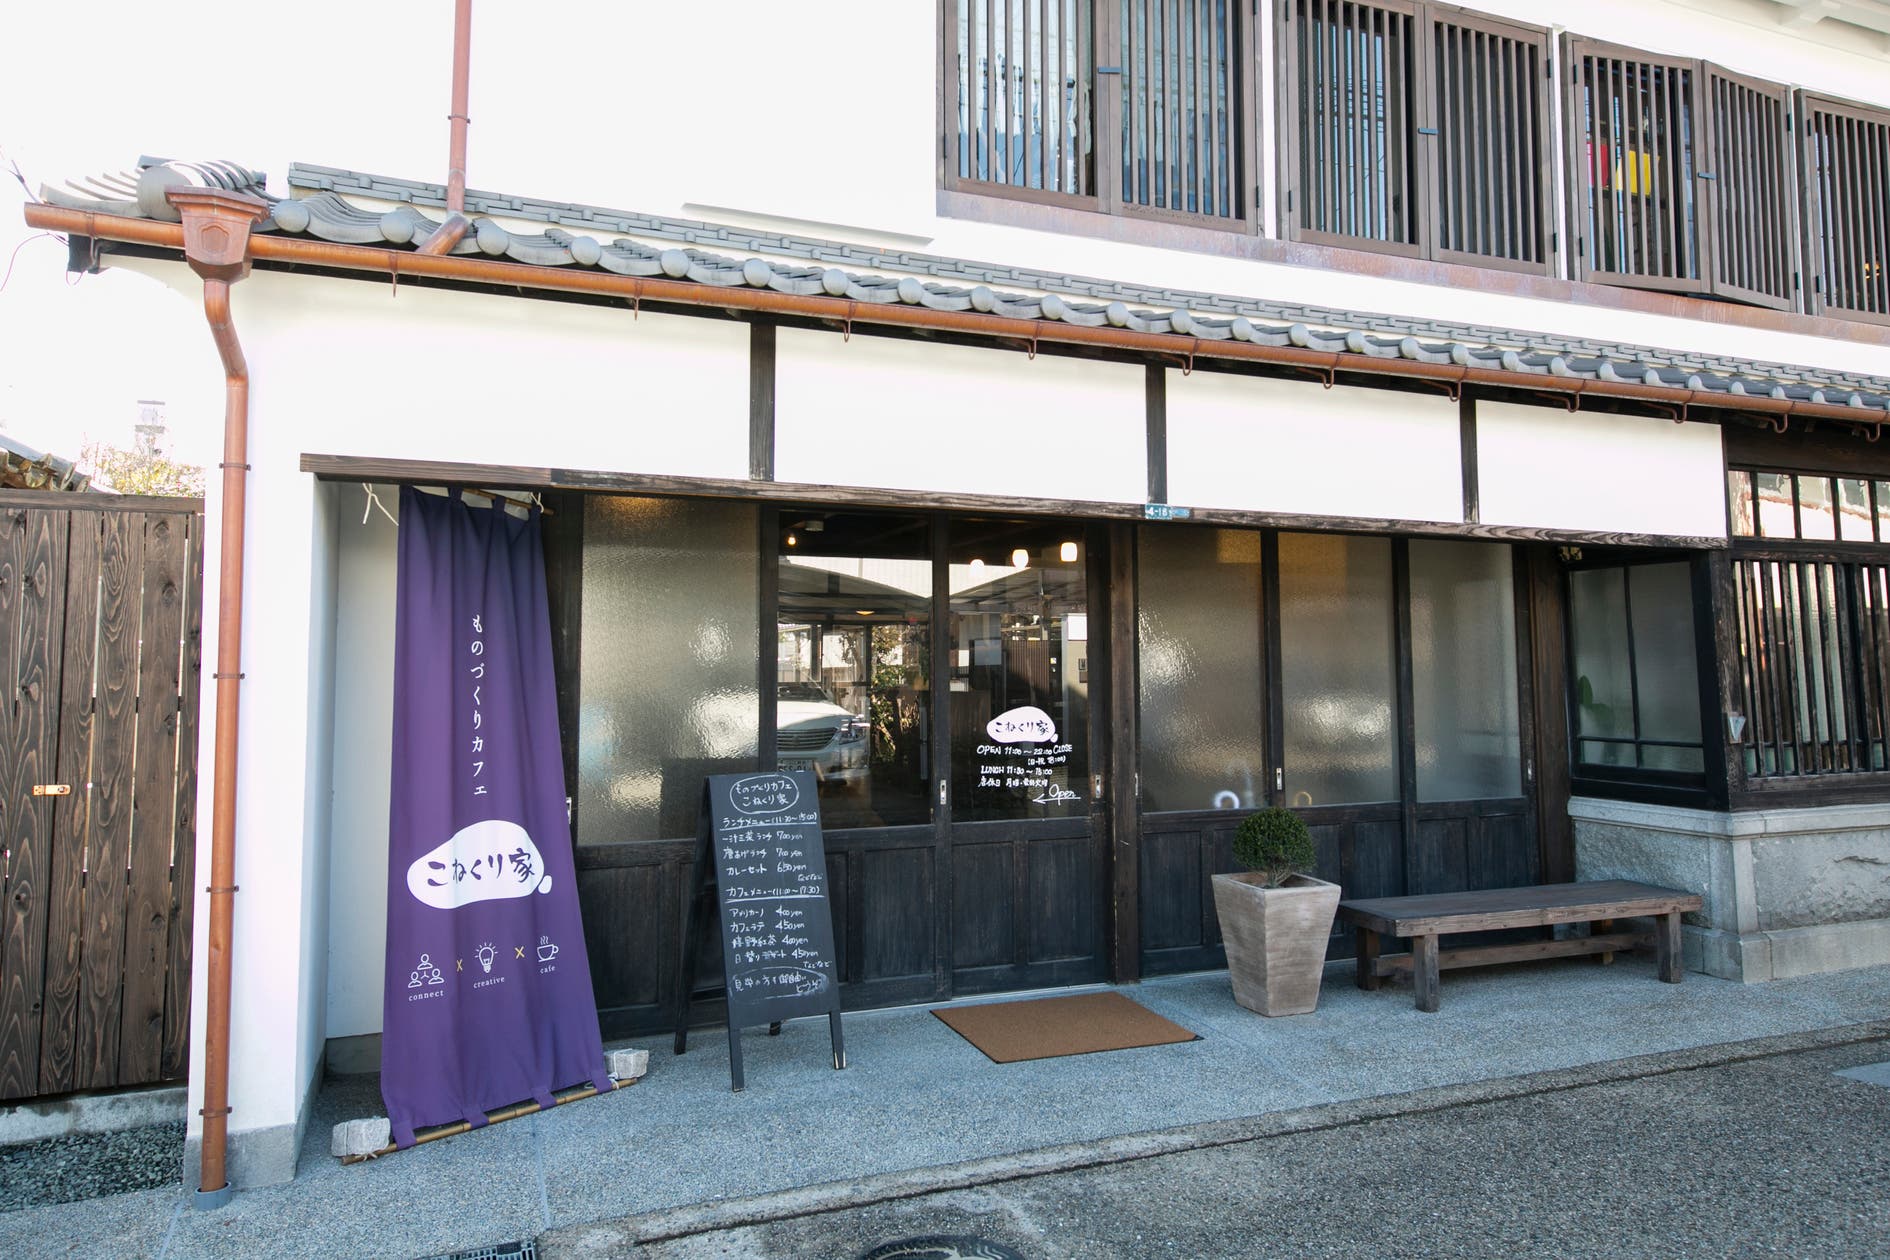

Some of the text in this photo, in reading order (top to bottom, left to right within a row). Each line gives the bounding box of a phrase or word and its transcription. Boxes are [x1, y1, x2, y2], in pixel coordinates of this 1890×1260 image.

[470, 614, 487, 796] ものづくりカフェ
[995, 719, 1049, 736] こねくり家
[976, 745, 1002, 756] OPEN
[1052, 744, 1073, 754] CLOSE
[980, 765, 1005, 775] LUNCH
[735, 781, 793, 794] ものづくりカフェ
[742, 793, 789, 807] こねくり家
[1048, 783, 1076, 806] Open
[427, 847, 535, 887] こねくり家
[726, 863, 768, 876] カレーセット
[729, 907, 764, 919] アメリカーノ
[730, 921, 765, 933] カフェラテ
[540, 964, 556, 974] cafe
[473, 975, 505, 989] creative
[408, 989, 445, 1002] connect
